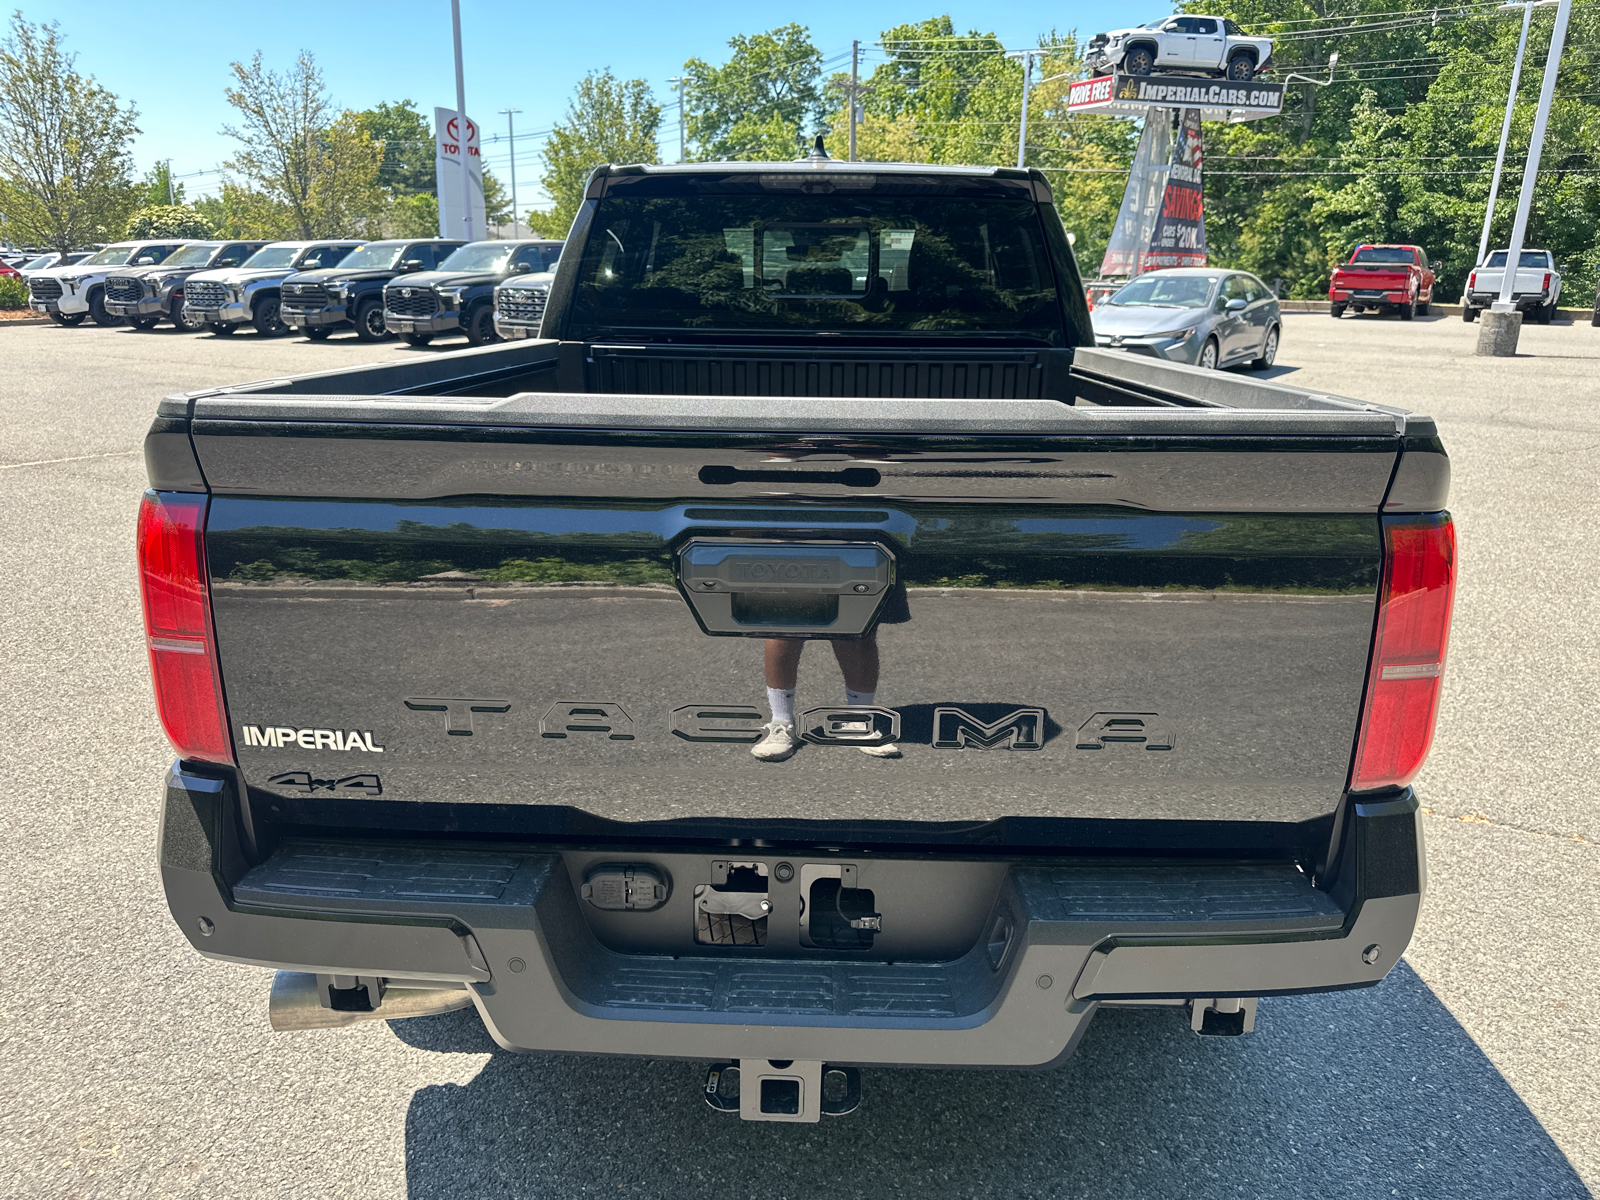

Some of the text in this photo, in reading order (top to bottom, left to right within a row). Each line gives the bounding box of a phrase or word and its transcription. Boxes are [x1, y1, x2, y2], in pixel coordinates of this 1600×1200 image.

[1069, 80, 1111, 105] DRIVE FREE
[1137, 81, 1280, 107] IMPERIALCARS.COM
[1163, 185, 1202, 221] SAVINGS
[735, 562, 834, 581] TOYOTA
[402, 697, 1176, 750] TACOMA
[242, 724, 384, 753] IMPERIAL
